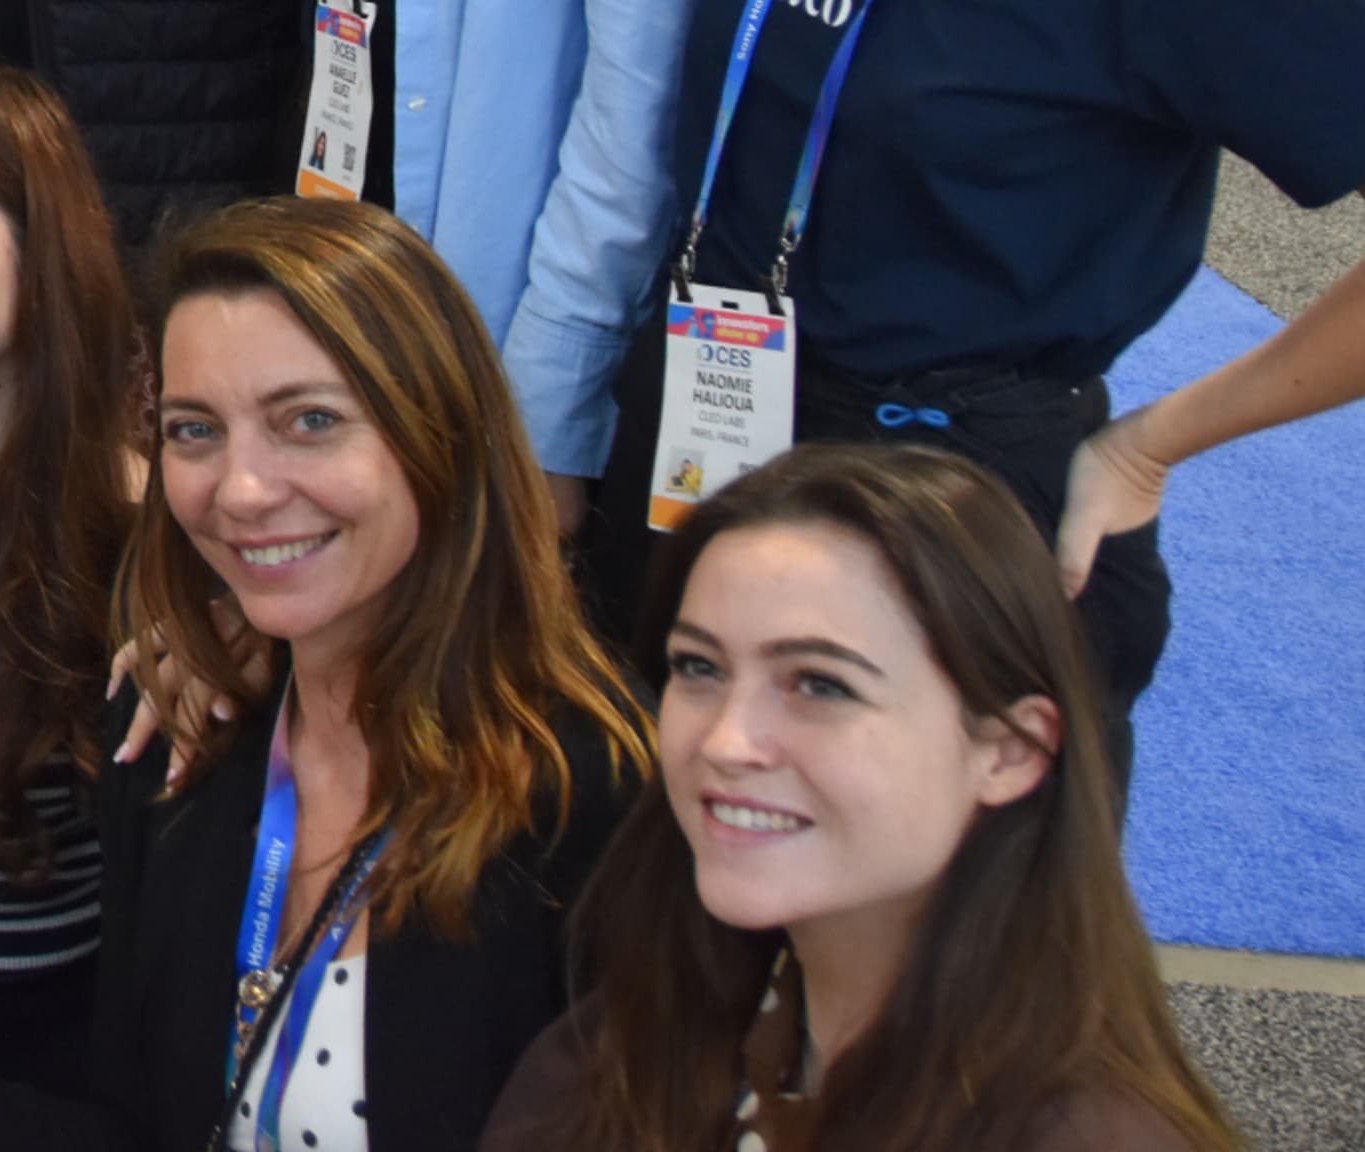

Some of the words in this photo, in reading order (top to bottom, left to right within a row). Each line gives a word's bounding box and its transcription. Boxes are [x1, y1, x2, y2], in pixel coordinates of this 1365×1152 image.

[736, 23, 758, 60] Sony
[715, 346, 752, 370] CES
[696, 369, 754, 395] NAOMIE
[692, 389, 755, 413] HALIOUA
[257, 836, 287, 910] Mobility
[247, 910, 270, 967] Honda
